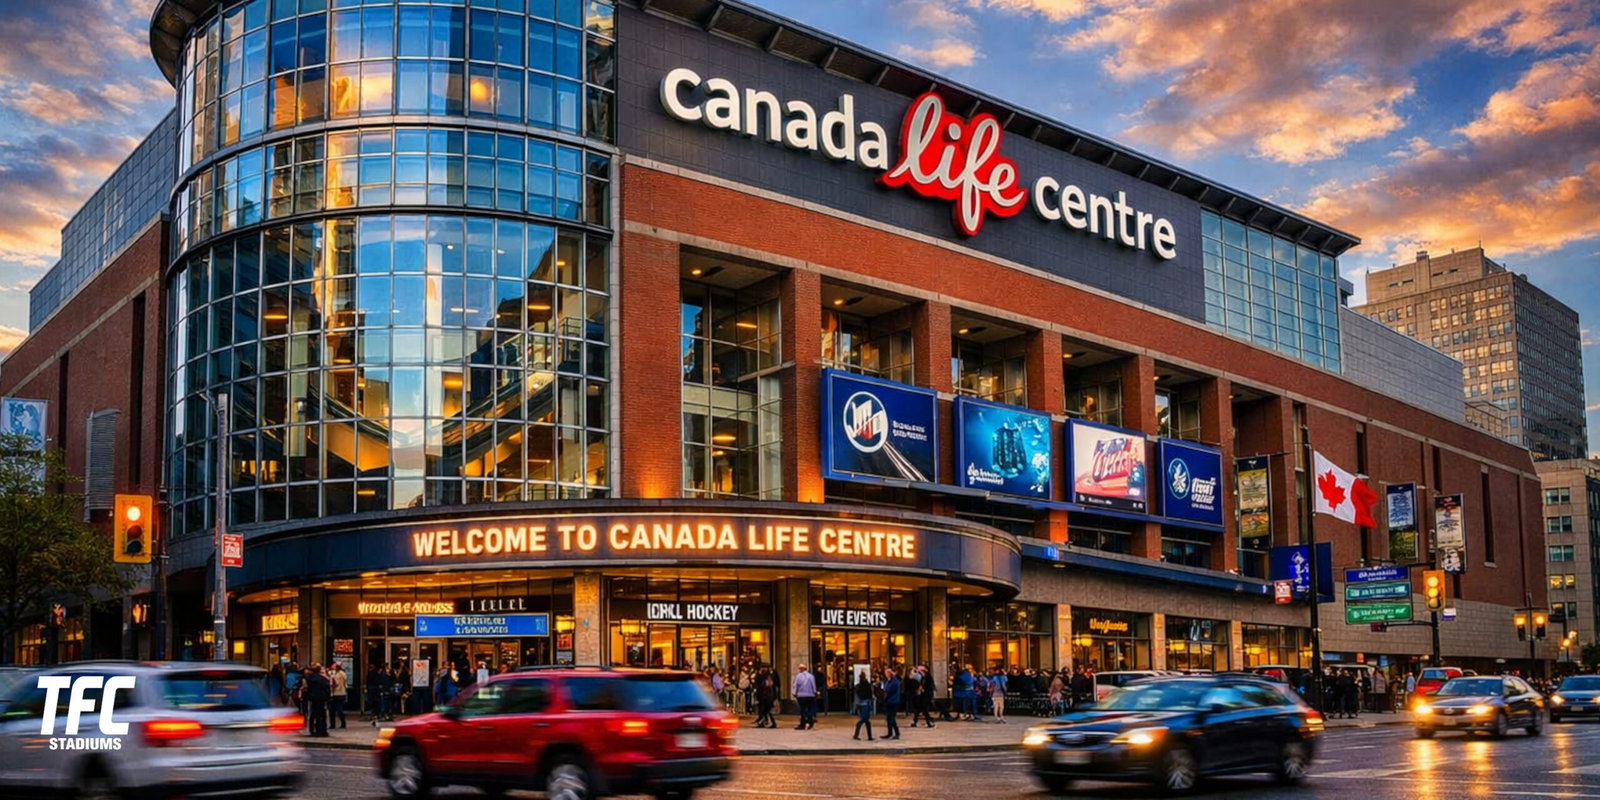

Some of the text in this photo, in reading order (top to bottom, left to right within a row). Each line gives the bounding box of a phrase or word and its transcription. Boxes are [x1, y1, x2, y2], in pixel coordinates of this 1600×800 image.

[660, 68, 1177, 260] canada life centre
[413, 523, 915, 559] WELCOME TO CANADA LIFE CENTRE
[687, 604, 739, 621] HOCKEY
[821, 609, 887, 626] LIVE EVENTS
